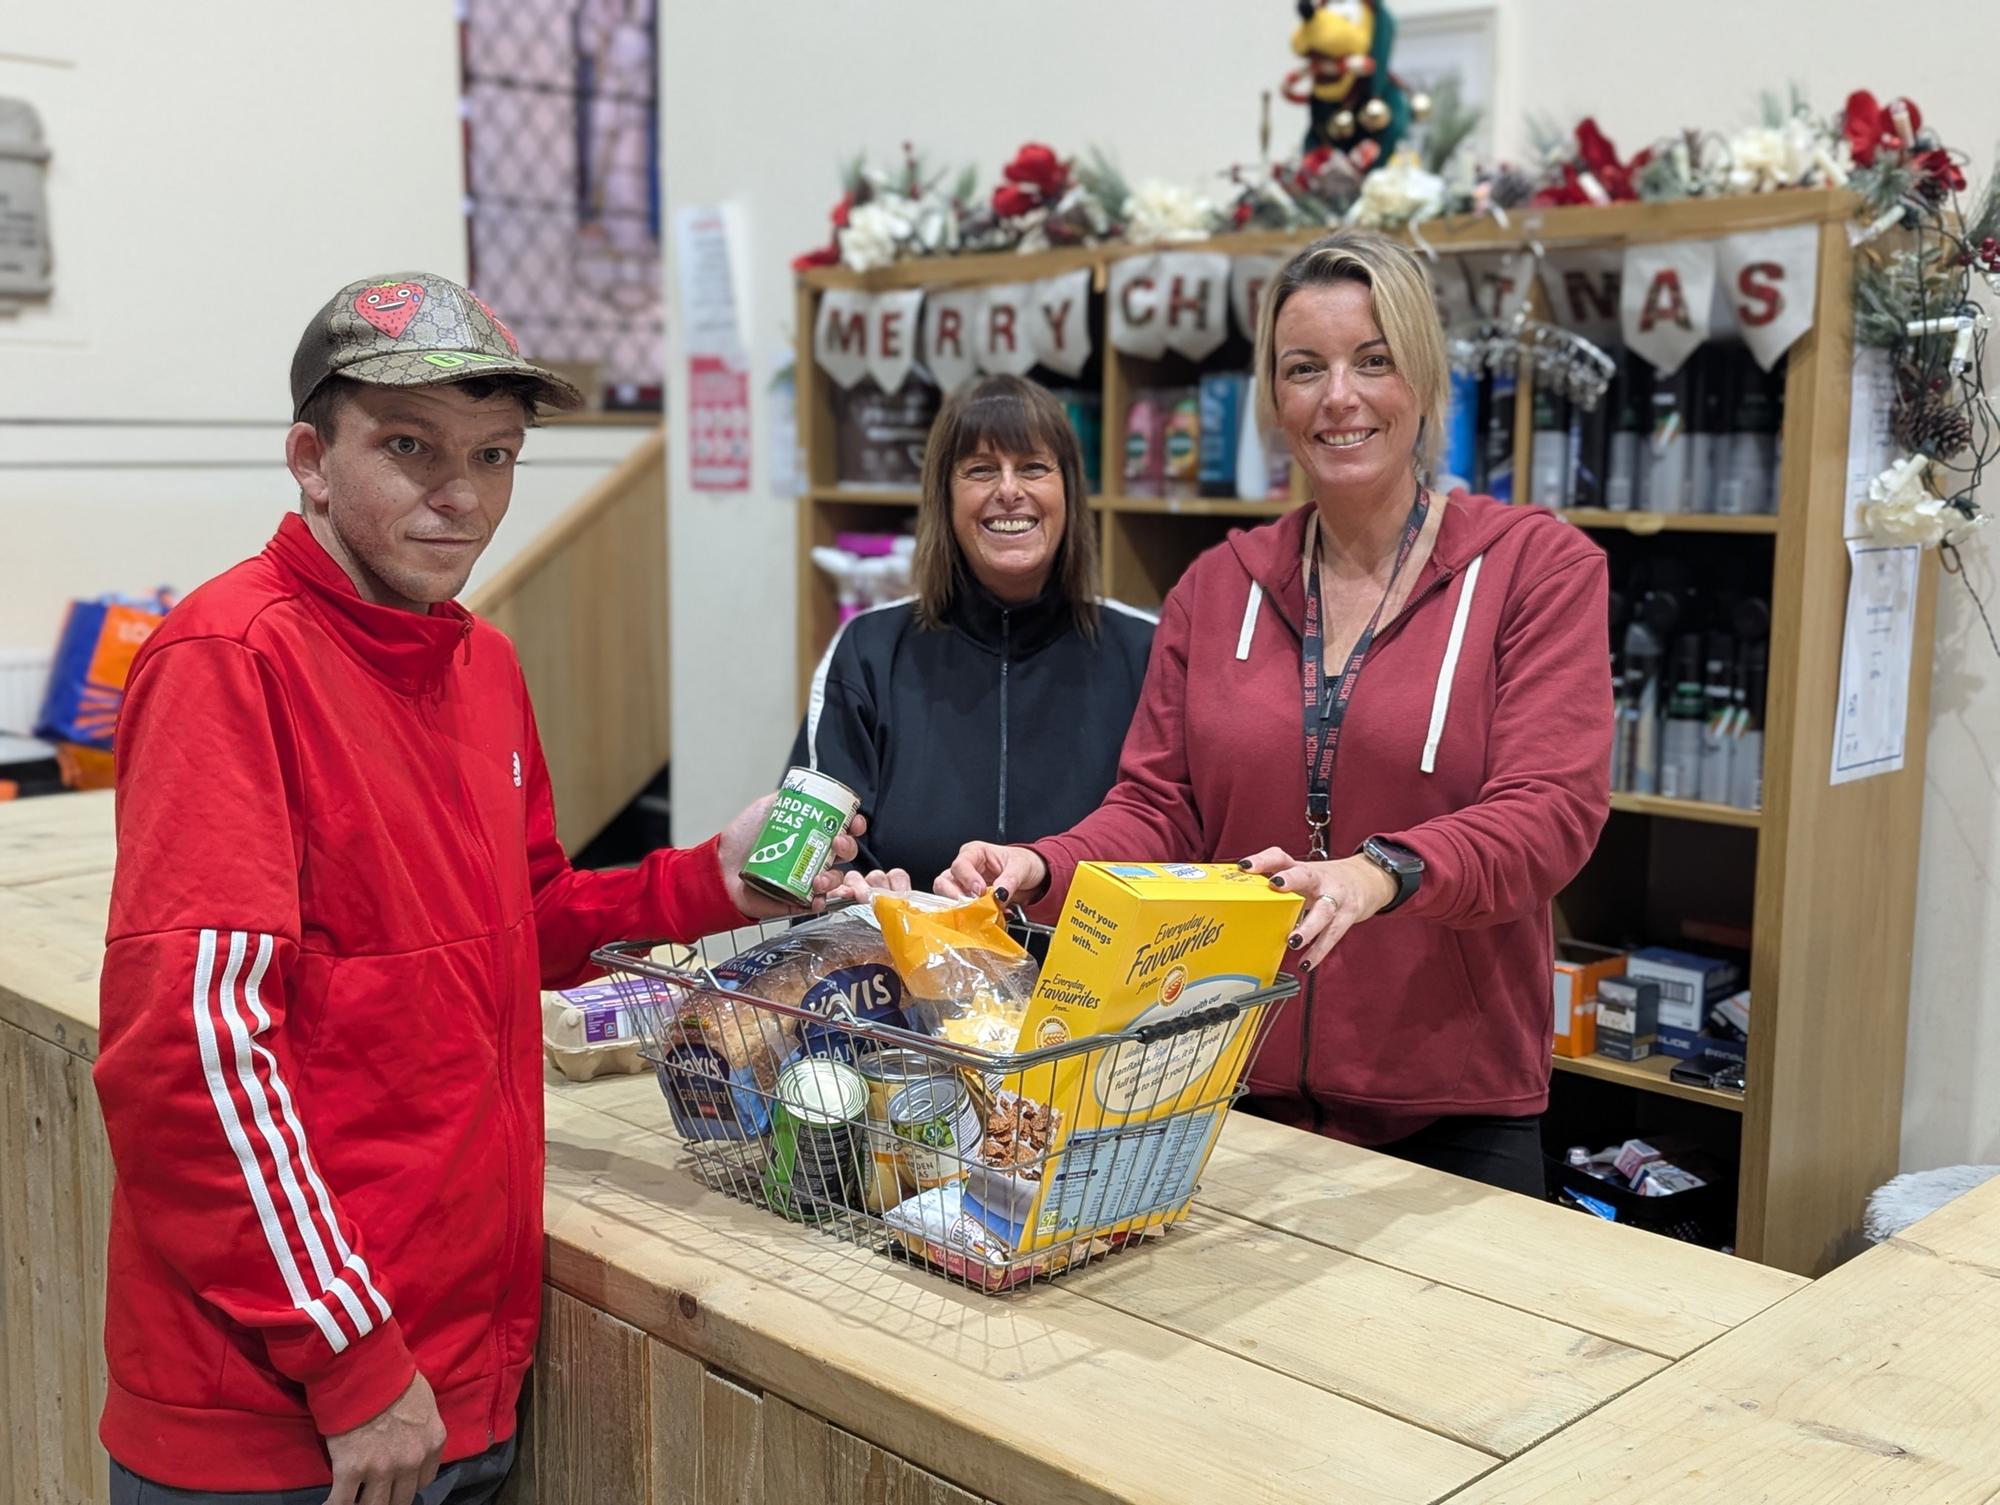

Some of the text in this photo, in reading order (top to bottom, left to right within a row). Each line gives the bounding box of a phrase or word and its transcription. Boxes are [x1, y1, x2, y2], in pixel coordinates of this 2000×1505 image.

[826, 301, 1072, 358] MERRY
[1306, 621, 1317, 638] THE
[1305, 661, 1316, 707] THE BRICK
[1339, 653, 1365, 700] THE BRICK
[1318, 727, 1339, 780] THE BRICK
[770, 809, 804, 829] PEAS
[774, 795, 823, 822] ARDEN
[1070, 915, 1112, 945] mornings
[1074, 899, 1119, 931] Start your
[1154, 914, 1206, 945] Everyday
[1125, 918, 1224, 985] Favourites
[1036, 979, 1101, 1010] Favourites
[1052, 973, 1086, 994] Everyday
